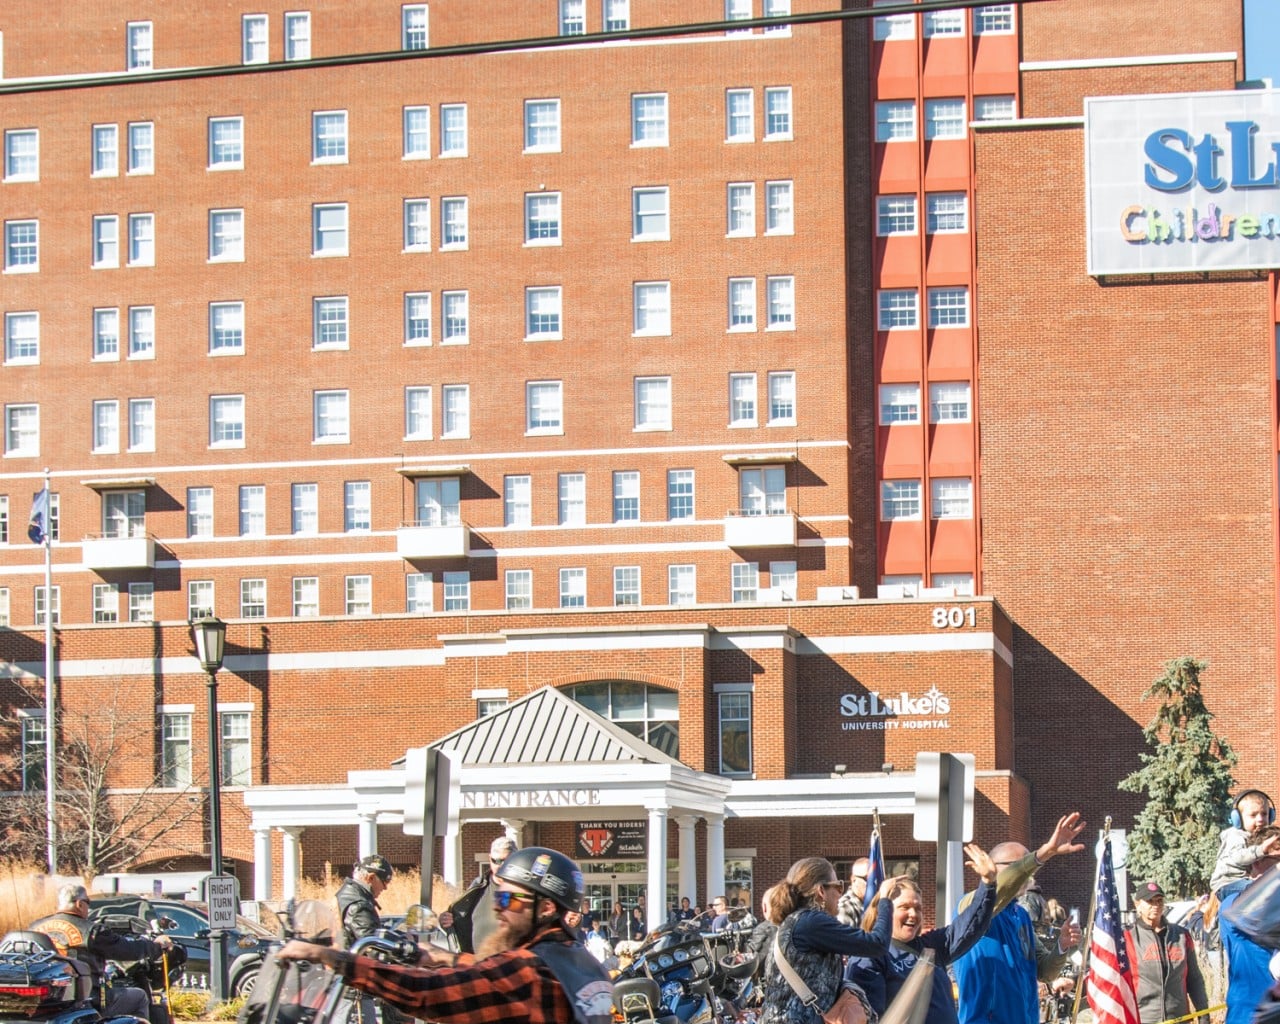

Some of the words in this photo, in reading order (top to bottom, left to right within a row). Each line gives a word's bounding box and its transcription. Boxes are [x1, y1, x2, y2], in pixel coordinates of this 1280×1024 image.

[932, 606, 977, 629] 801
[841, 721, 900, 730] UNIVERSITY
[902, 719, 951, 729] HOSPITAL
[484, 789, 601, 808] ENTRANCE
[211, 884, 232, 894] RIGHT
[213, 898, 232, 908] TURN
[214, 911, 232, 921] ONLY
